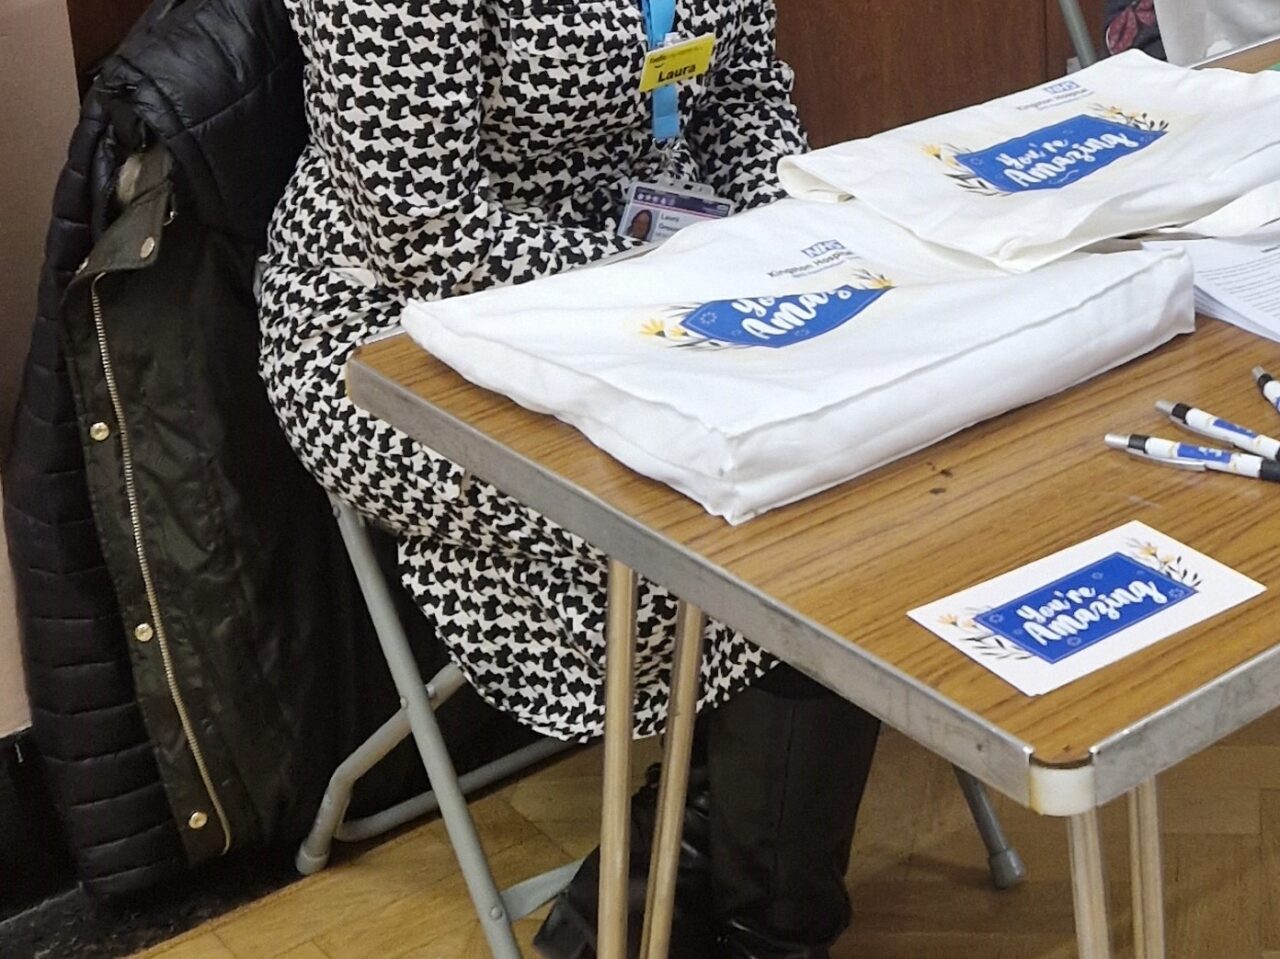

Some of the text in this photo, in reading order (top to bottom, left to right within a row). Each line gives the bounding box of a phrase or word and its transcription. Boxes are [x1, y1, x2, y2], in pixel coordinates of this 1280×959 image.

[658, 64, 696, 82] Laura
[996, 139, 1068, 170] You're
[1003, 131, 1139, 187] Amazing
[801, 239, 845, 258] NHS
[1016, 584, 1096, 624] You're
[1022, 579, 1169, 646] Amazing
